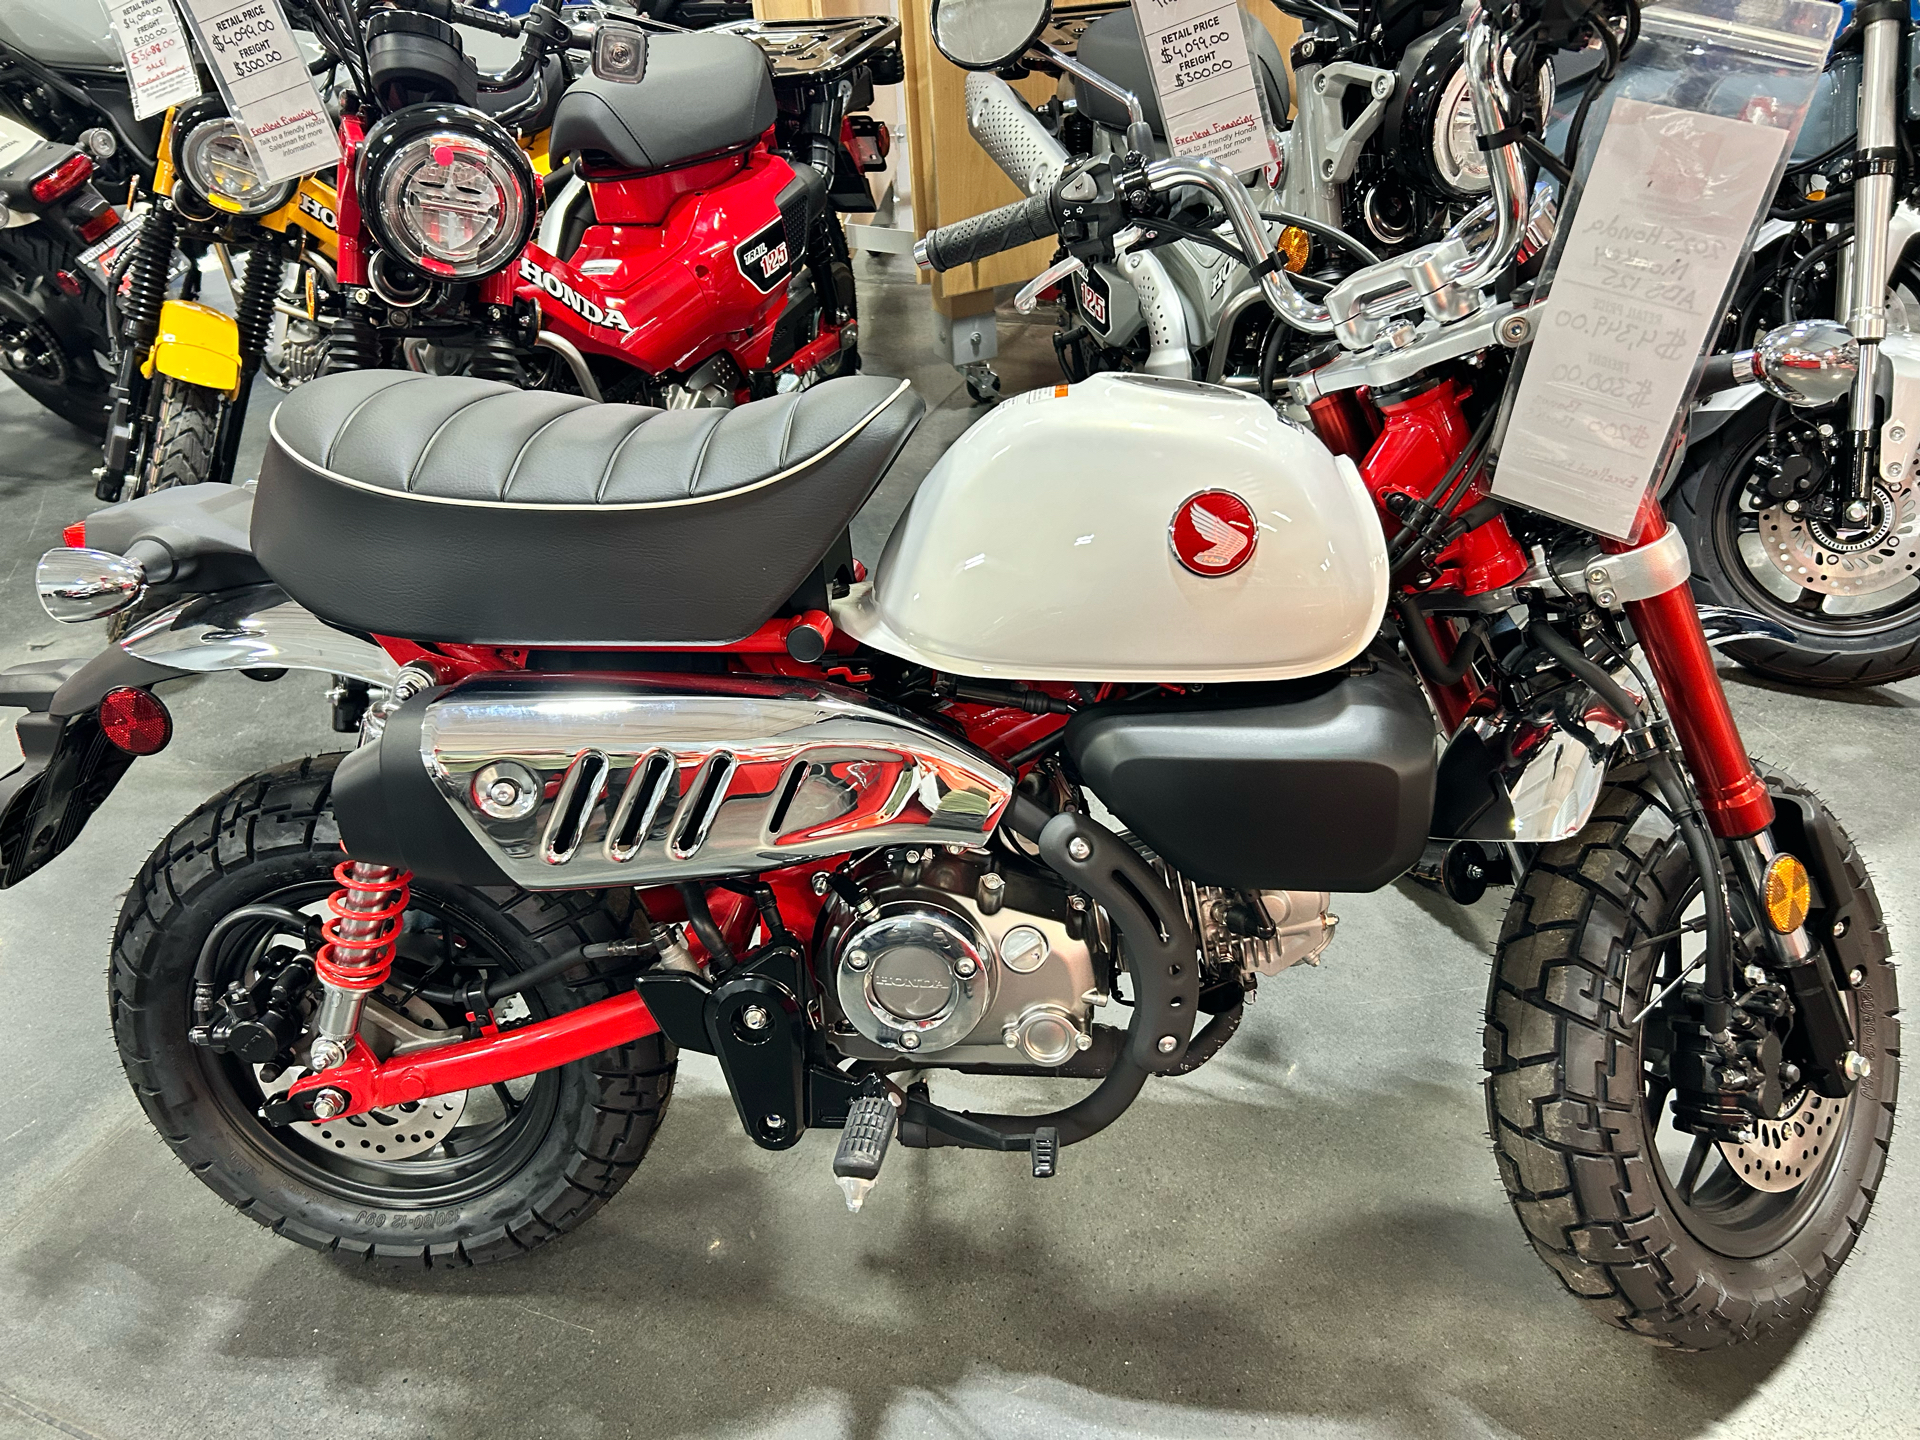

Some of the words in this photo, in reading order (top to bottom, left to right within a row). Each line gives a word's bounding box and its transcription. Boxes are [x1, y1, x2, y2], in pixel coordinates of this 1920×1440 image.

[122, 3, 142, 16] RETAIL
[216, 14, 243, 32] RETAIL
[242, 4, 266, 21] PRICE
[133, 27, 168, 47] $300.00
[137, 19, 160, 34] FREIGHT
[211, 19, 275, 53] $4,099.00
[1161, 27, 1192, 46] RETAIL
[1193, 16, 1220, 34] PRICE
[238, 39, 271, 59] FREIGHT
[1160, 31, 1229, 64] $4,099.00
[1179, 50, 1216, 71] FREIGHT
[232, 50, 282, 78] $300.00
[1174, 59, 1233, 88] $300.00
[259, 136, 271, 147] Talk
[271, 134, 278, 143] to
[283, 125, 305, 138] friendly
[305, 117, 326, 130] Honda
[268, 137, 298, 153] Salesman
[297, 134, 307, 144] for
[307, 128, 323, 139] more
[1179, 147, 1193, 157] Talk
[1208, 133, 1233, 147] friendly
[1234, 125, 1257, 138] Honda
[1223, 141, 1233, 150] for
[1234, 135, 1252, 147] more
[743, 242, 768, 266] TRAIL
[760, 241, 788, 278] 125
[518, 257, 634, 333] HONDA
[1081, 281, 1105, 325] 125
[875, 974, 949, 990] HONDA
